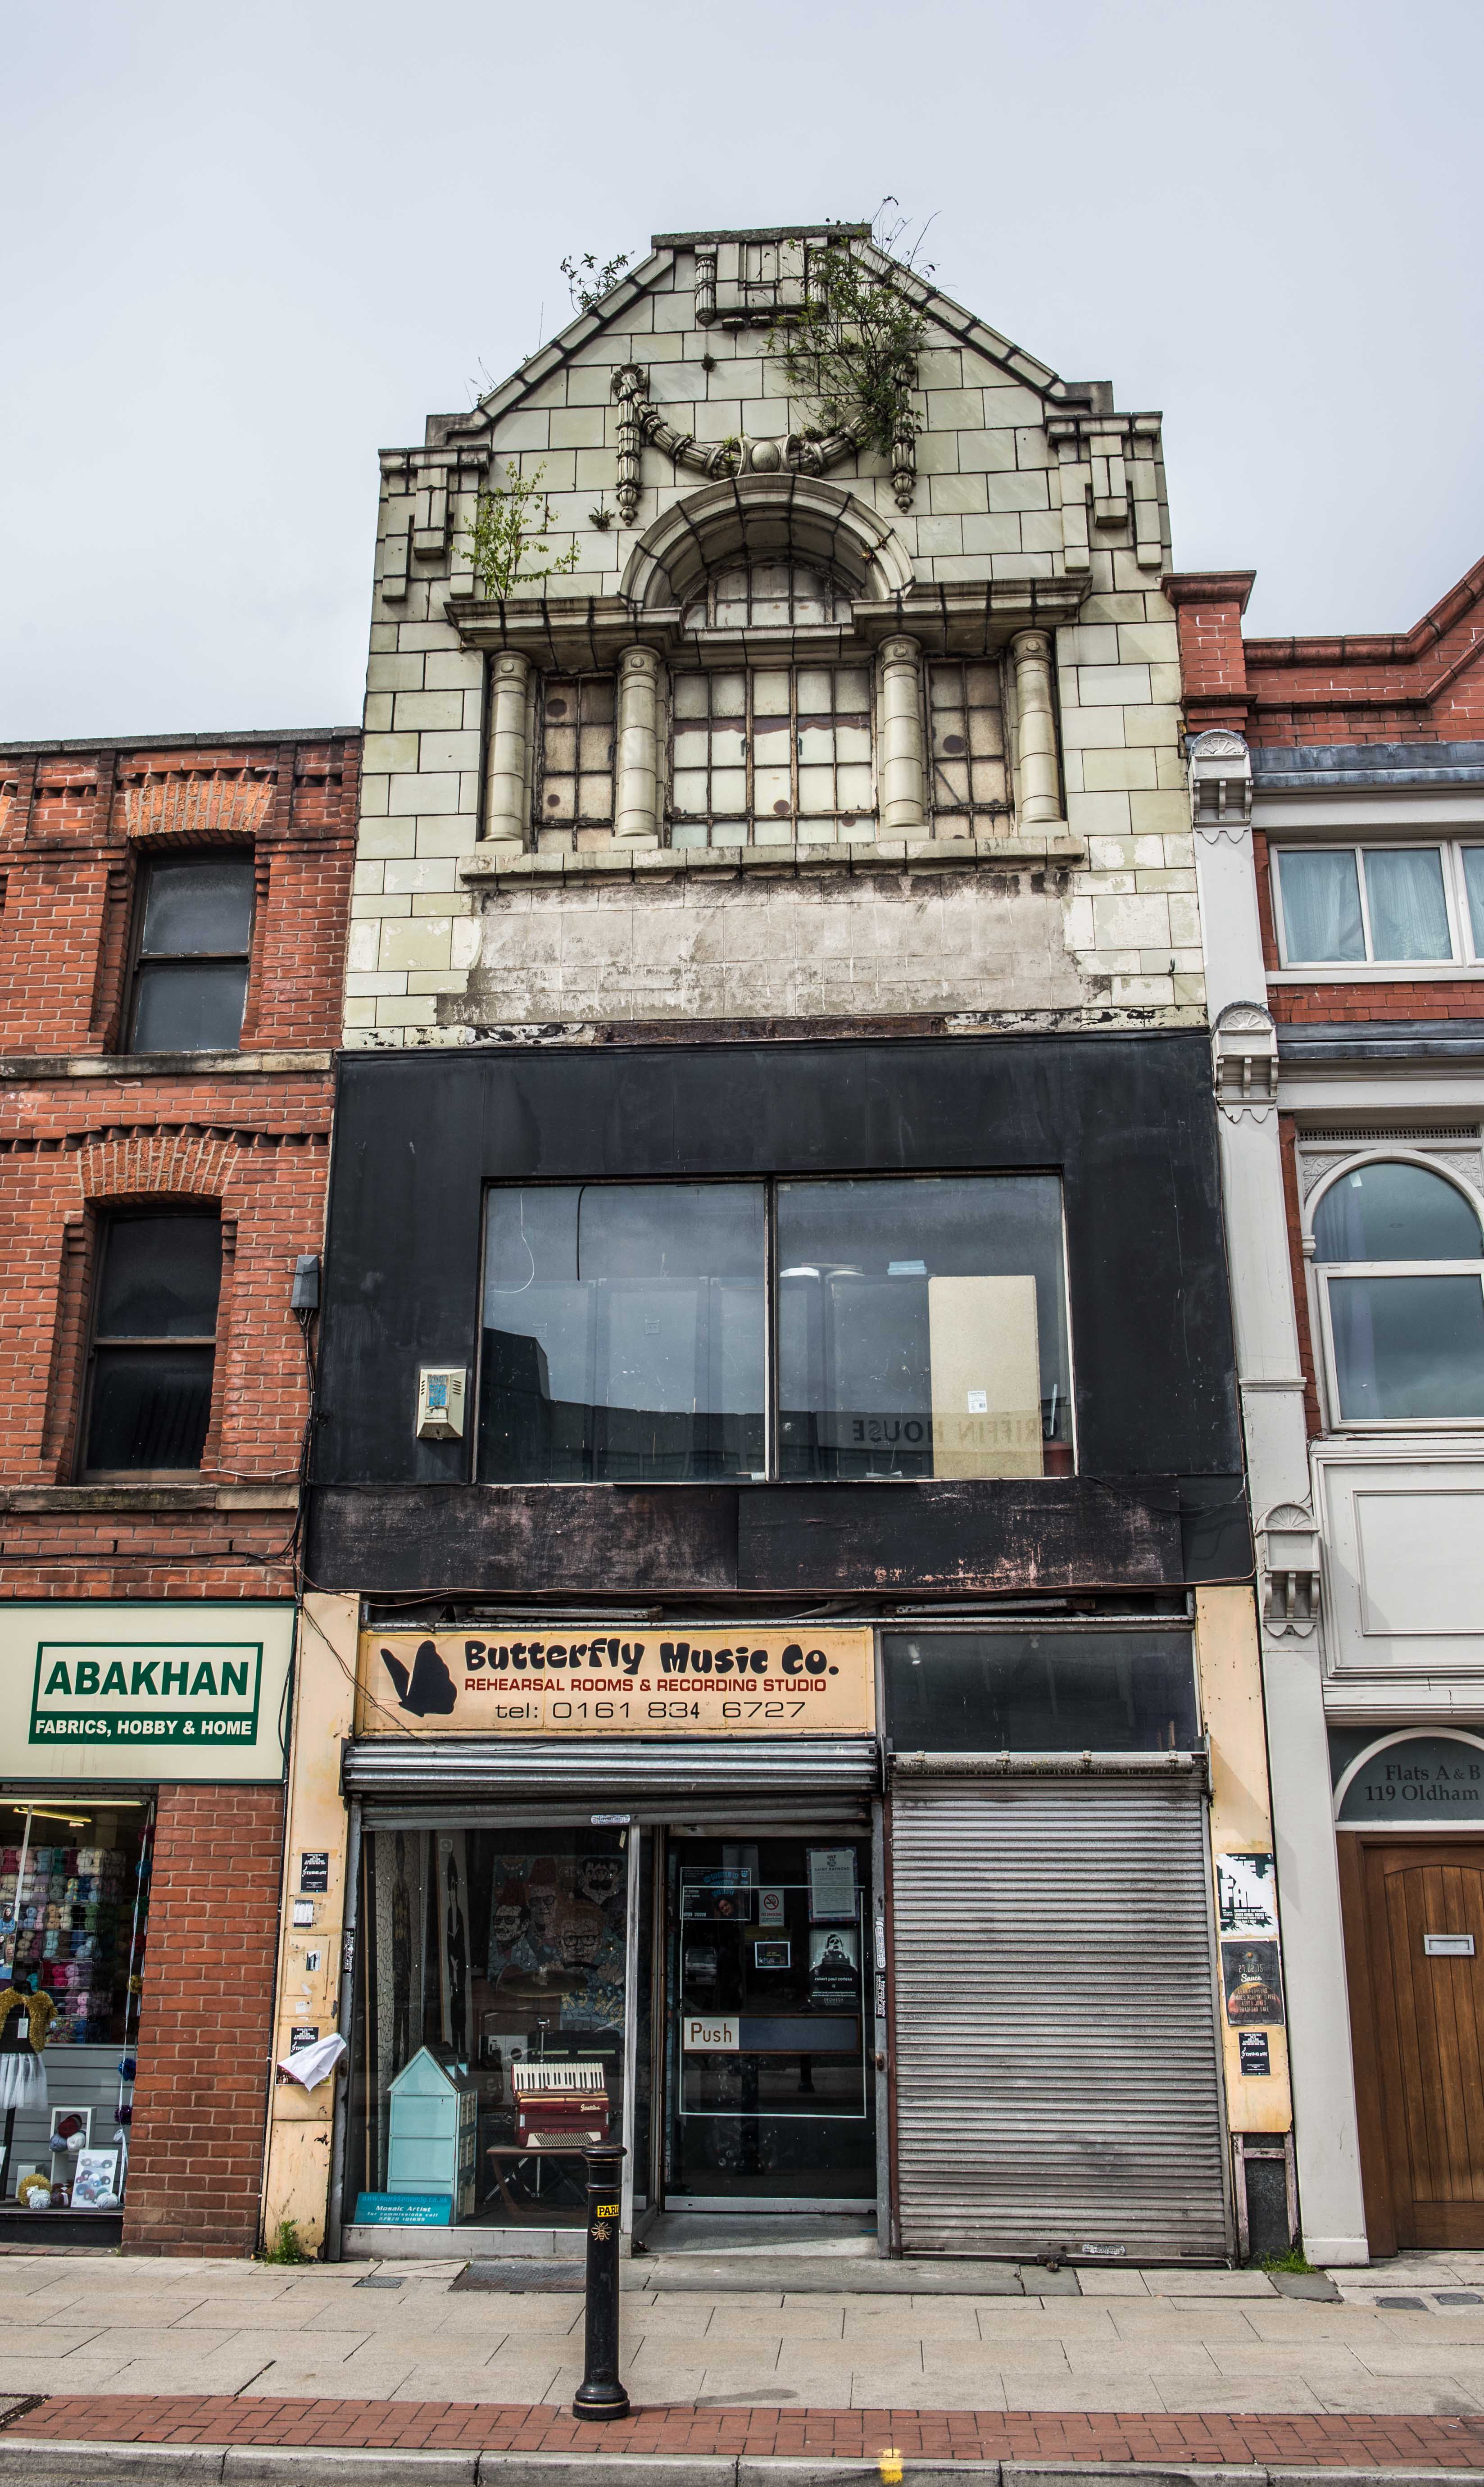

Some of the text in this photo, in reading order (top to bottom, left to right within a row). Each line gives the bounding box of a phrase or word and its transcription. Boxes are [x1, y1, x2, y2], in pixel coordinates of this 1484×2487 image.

[465, 1638, 839, 1675] Butterfly Music Co.
[44, 1661, 249, 1695] ABAKHAN
[465, 1678, 826, 1692] REHEARSAL ROOMS & RECORDING STUDIO
[495, 1702, 806, 1719] tel: 0161 834 6727
[36, 1720, 252, 1737] FABRICS, HOBBY & HOME
[1384, 1764, 1481, 1780] Flats A & B
[1364, 1784, 1480, 1801] 119 Oldham
[1241, 1973, 1262, 1982] Sauce
[691, 2022, 731, 2042] Push
[362, 2195, 448, 2204] www.markkennedy.co.uk
